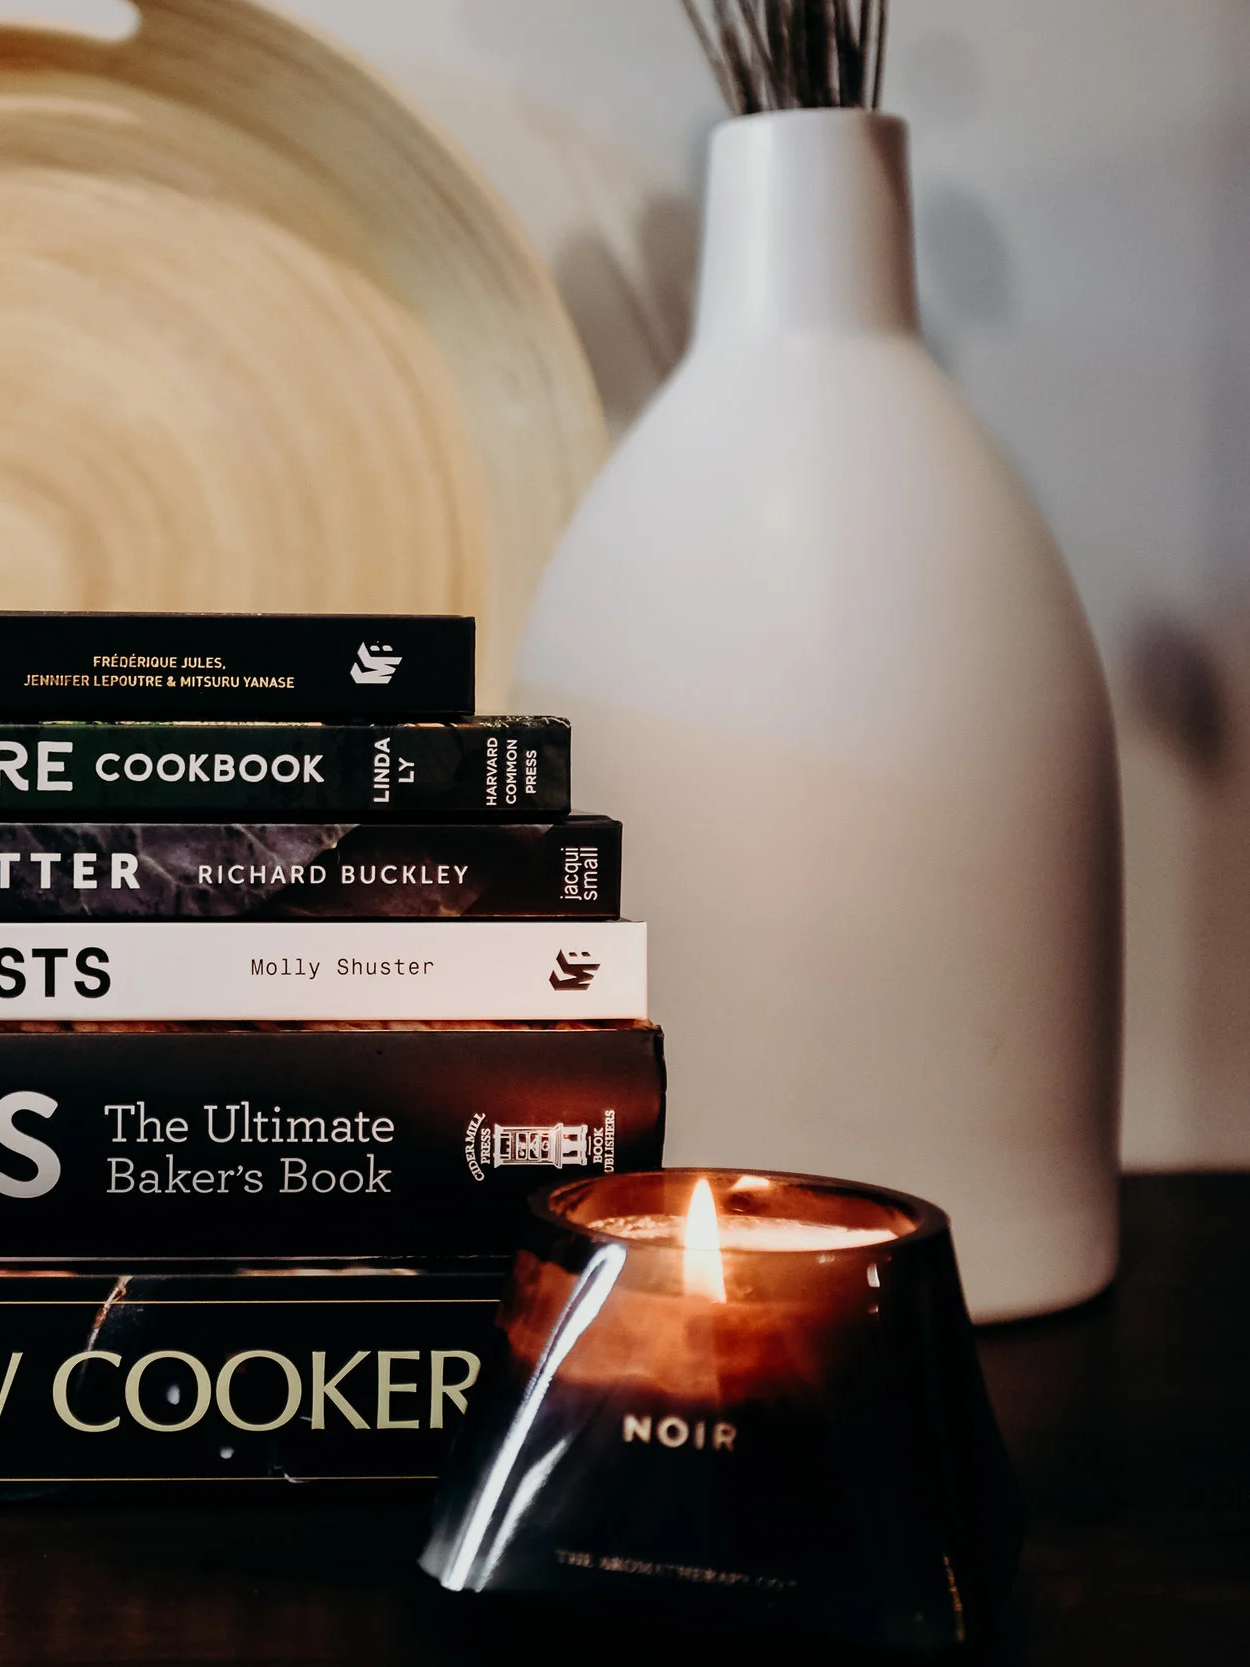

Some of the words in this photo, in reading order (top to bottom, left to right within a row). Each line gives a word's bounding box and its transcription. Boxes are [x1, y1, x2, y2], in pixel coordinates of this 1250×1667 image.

[92, 653, 178, 669] FRÉDÉRIQUE
[180, 656, 226, 670] JULES,
[23, 674, 90, 687] JENNIFER
[93, 675, 163, 688] LEPOUTRE
[166, 675, 177, 688] &
[180, 675, 240, 688] MITSURU
[243, 676, 295, 689] YANASE
[95, 752, 325, 783] COOKBOOK
[373, 737, 391, 803] LINDA
[398, 757, 415, 783] LY
[485, 737, 498, 806] HARVARD
[505, 739, 518, 805] COMMON
[525, 749, 537, 794] PRESS
[198, 862, 327, 885] RICHARD
[341, 864, 469, 885] BUCKLEY
[559, 847, 582, 901] jacqui
[578, 847, 599, 901] small
[251, 958, 321, 980] Molly
[337, 957, 434, 976] Shuster
[104, 1100, 189, 1143] The
[203, 1100, 395, 1143] Ultimate
[465, 1112, 486, 1144] MILL
[603, 1108, 616, 1173] UBLISHERS
[465, 1144, 485, 1181] CIDER
[480, 1127, 492, 1165] PRESS
[592, 1127, 604, 1164] BOOK
[106, 1153, 264, 1194] Baker's
[279, 1153, 392, 1194] Book
[52, 1347, 481, 1433] COOKER
[623, 1414, 738, 1450] NOIR
